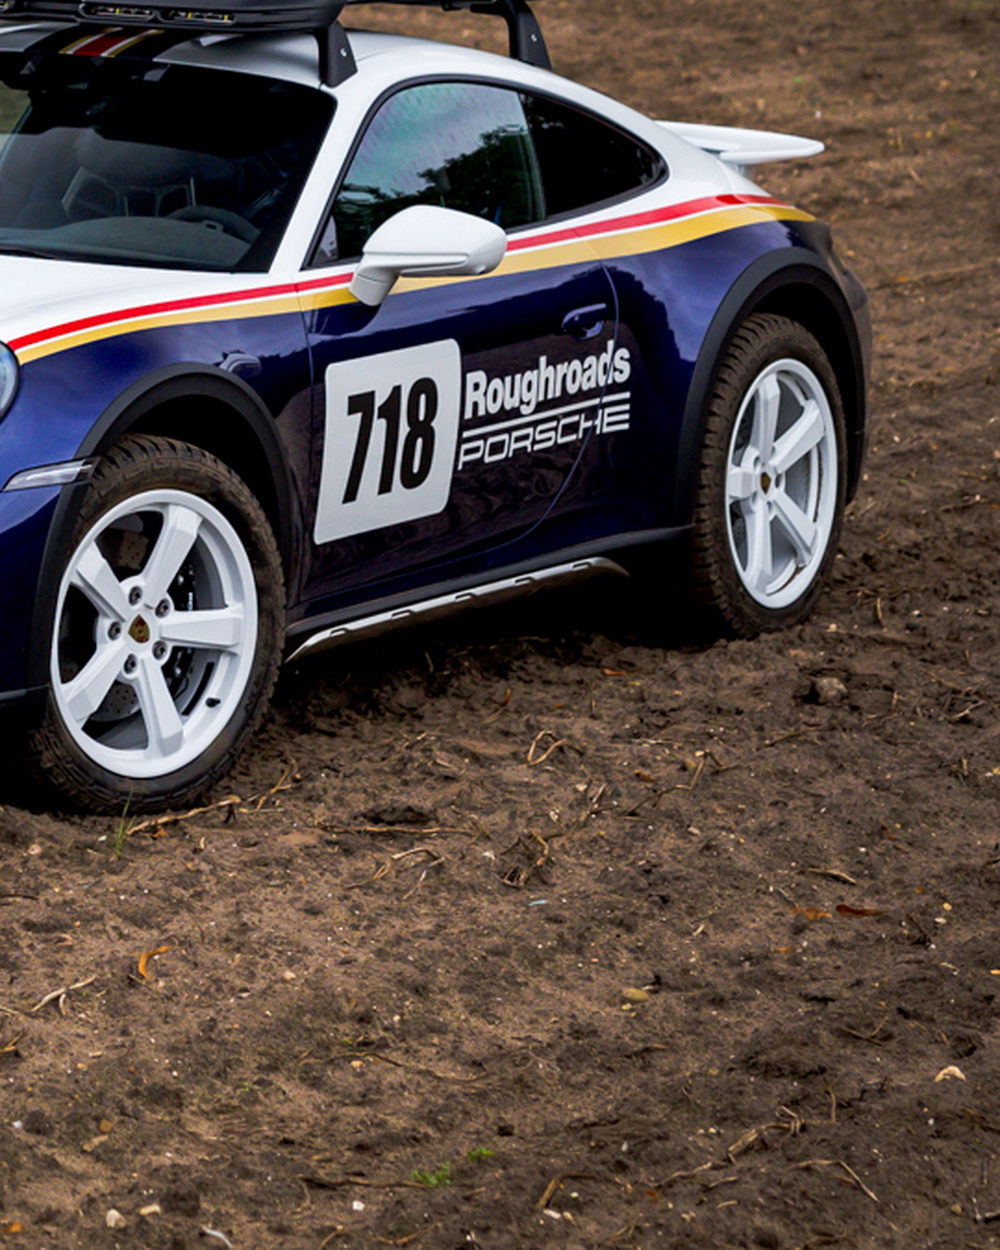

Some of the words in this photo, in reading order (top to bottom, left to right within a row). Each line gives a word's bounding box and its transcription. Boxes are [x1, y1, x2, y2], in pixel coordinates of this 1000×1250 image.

[464, 339, 631, 420] Roughroads
[342, 377, 438, 505] 718
[458, 403, 630, 471] PORSCHE
